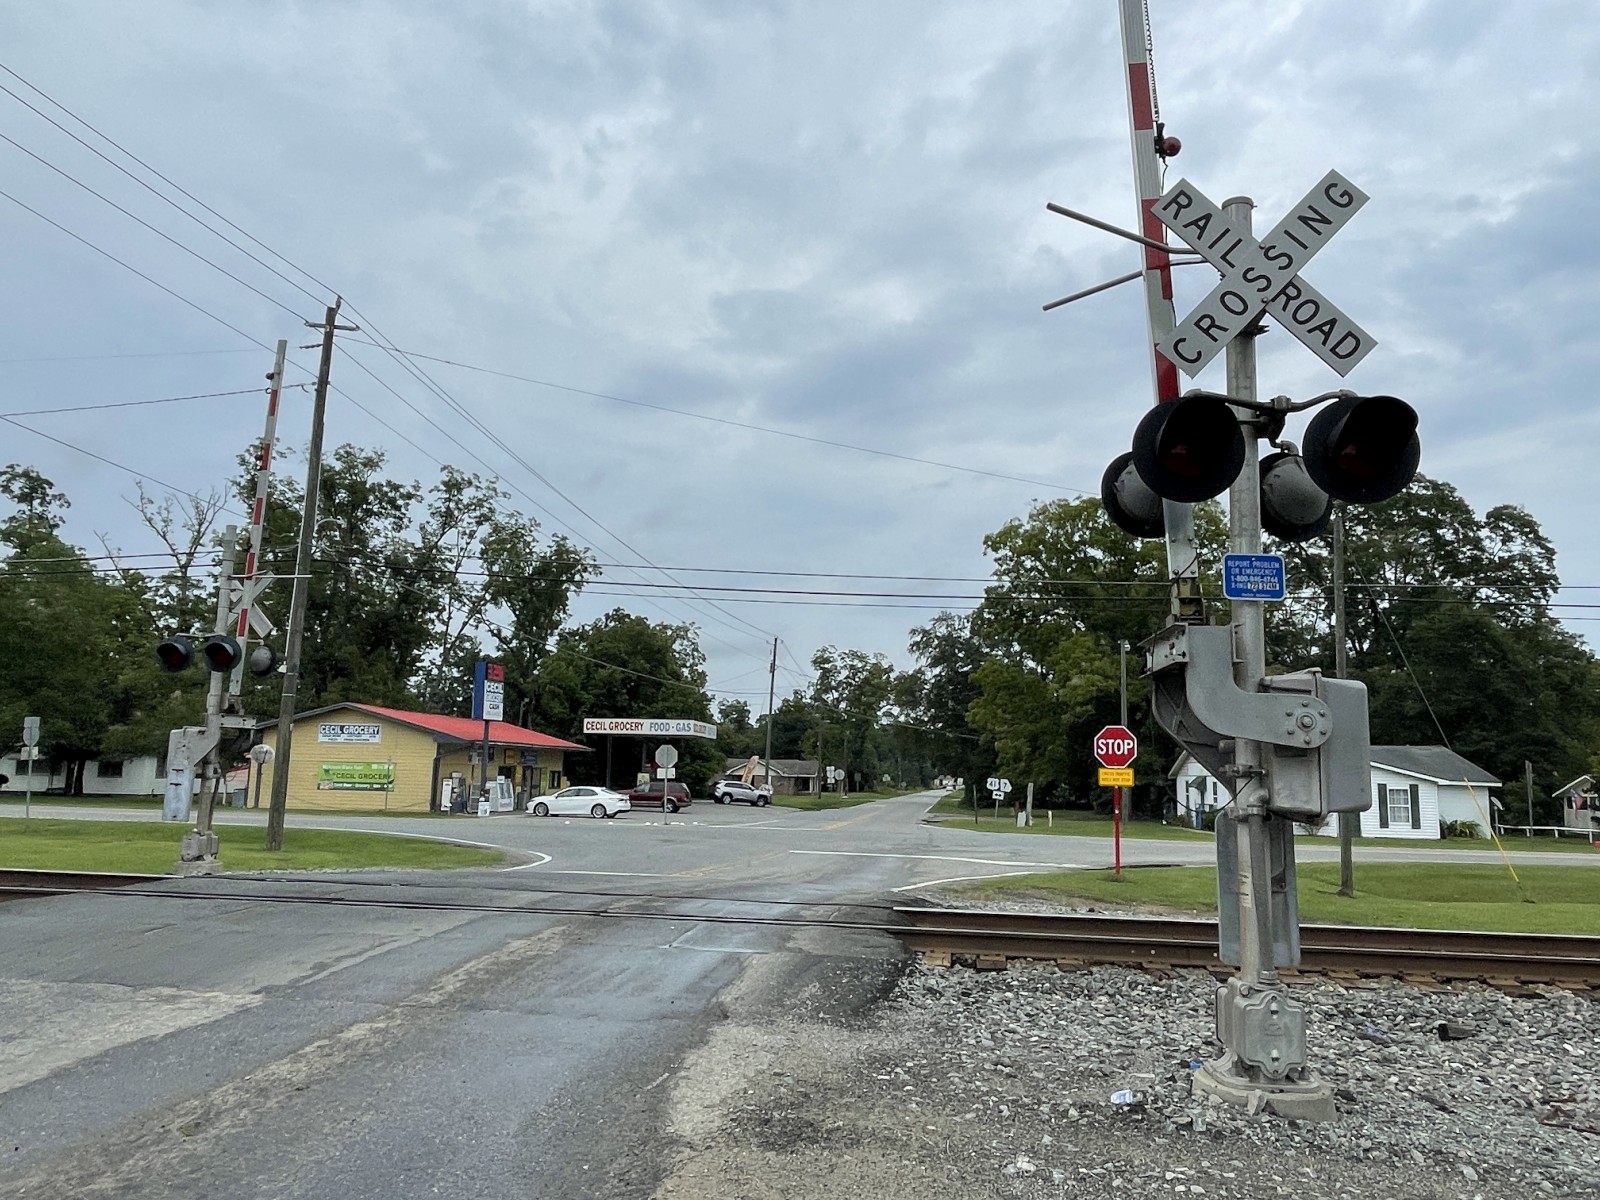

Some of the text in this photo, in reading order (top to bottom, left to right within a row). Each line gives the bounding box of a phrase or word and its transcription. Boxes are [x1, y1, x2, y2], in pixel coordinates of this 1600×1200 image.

[1172, 182, 1355, 364] CROSSING
[1241, 568, 1277, 576] EMERGENCY
[486, 681, 504, 693] CECIL
[320, 725, 379, 734] CECIL GROCERY
[585, 721, 607, 731] CECIL
[608, 721, 644, 731] GROCERY
[649, 722, 670, 732] FOOD
[675, 722, 691, 732] GAS
[1097, 738, 1134, 755] STOP
